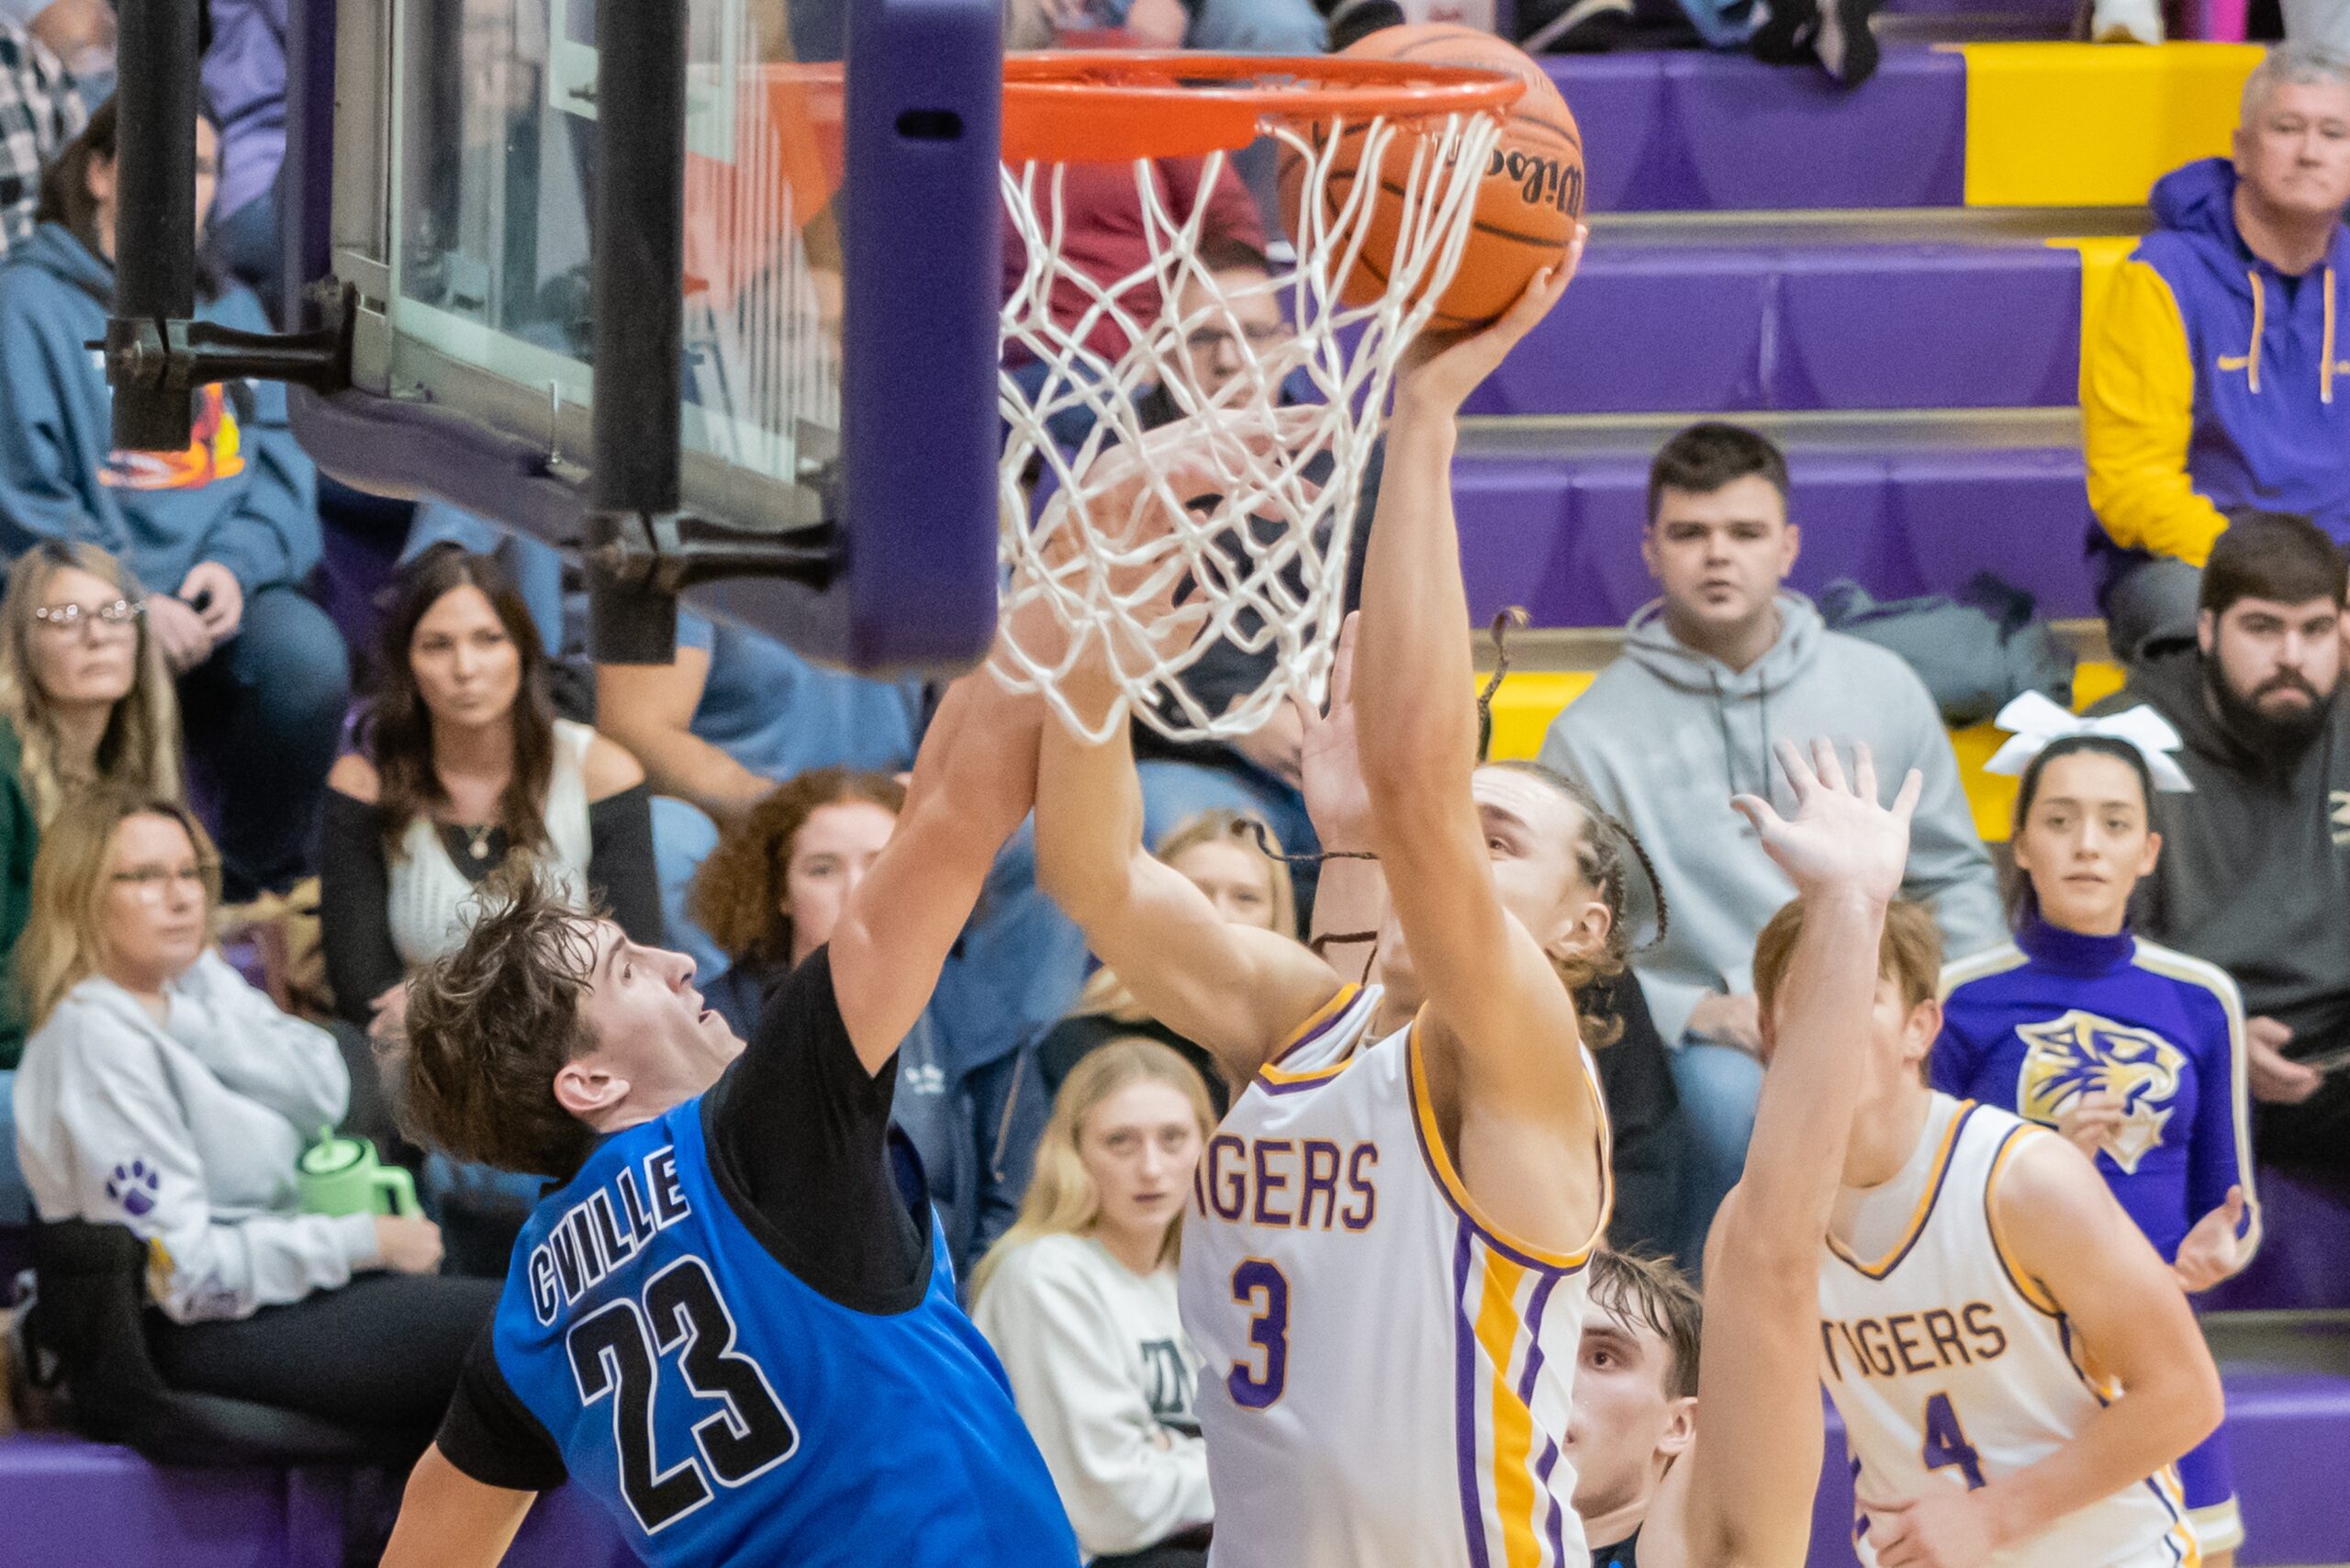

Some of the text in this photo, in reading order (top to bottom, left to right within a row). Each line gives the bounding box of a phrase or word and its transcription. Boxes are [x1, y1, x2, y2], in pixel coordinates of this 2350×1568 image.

[528, 1144, 692, 1327] CVILLE
[1193, 1133, 1381, 1233] IGERS
[565, 1253, 800, 1536] 23
[1226, 1255, 1292, 1412] 3
[1921, 1388, 1987, 1493] 4
